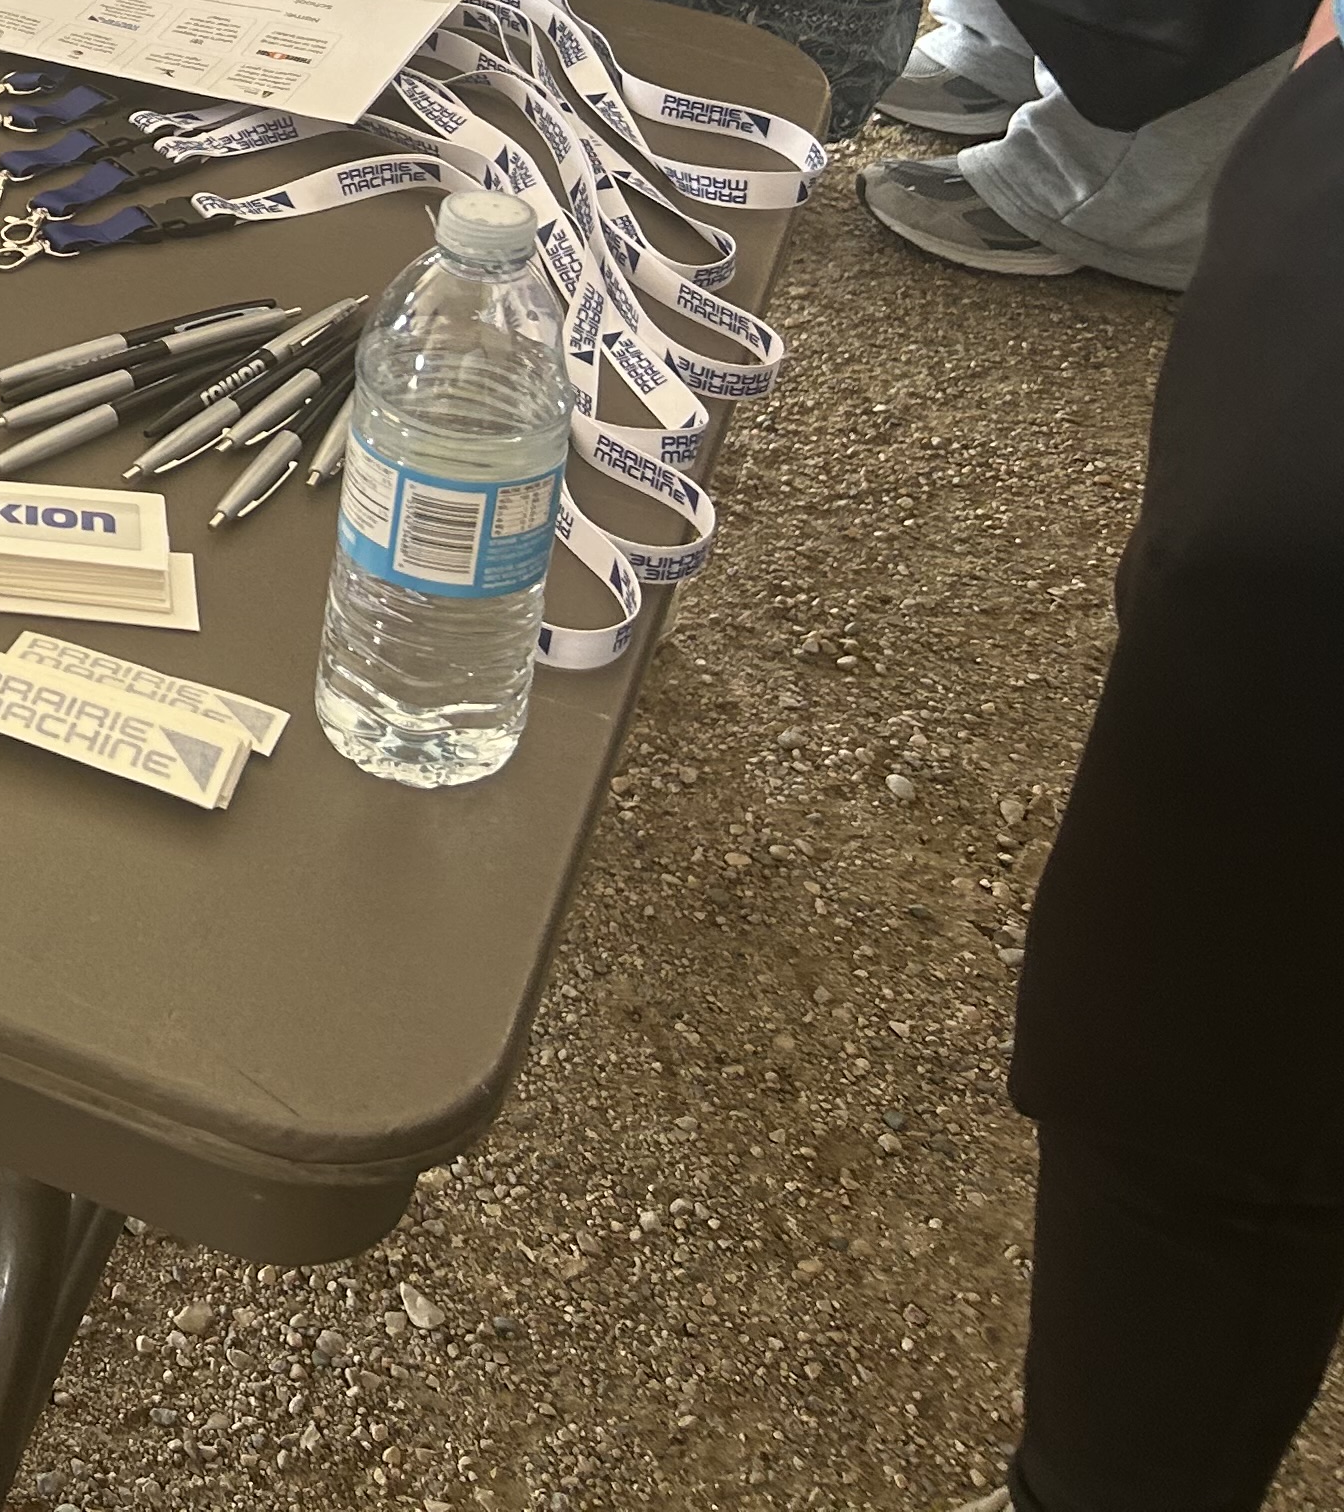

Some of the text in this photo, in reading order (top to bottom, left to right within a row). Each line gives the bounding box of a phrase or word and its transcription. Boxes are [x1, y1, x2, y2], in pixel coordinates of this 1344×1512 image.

[661, 105, 754, 133] MACHINE
[664, 94, 743, 120] PRAIRIE
[222, 116, 294, 145] MACHINE
[239, 128, 299, 151] PRAIRIE
[337, 161, 412, 185] PRAIRIE
[342, 172, 427, 197] MACHINE
[664, 166, 748, 192] MACHINE
[676, 181, 747, 205] PRAIRIE
[546, 244, 577, 299] PRAIRIE
[570, 282, 596, 351] MACHINE
[583, 290, 605, 350] PRAIRIE
[677, 295, 761, 348] MACHINE
[680, 283, 750, 329] PRAIRIE
[201, 359, 267, 406] rokion
[612, 349, 656, 395] PRAIRIE
[619, 338, 667, 386] MACHINE
[678, 355, 773, 386] MACHINE
[688, 376, 770, 397] PRAIRIE
[594, 448, 686, 506] MACHINE
[597, 434, 677, 485] PRAIRIE
[27, 638, 210, 706] PRAIRIE
